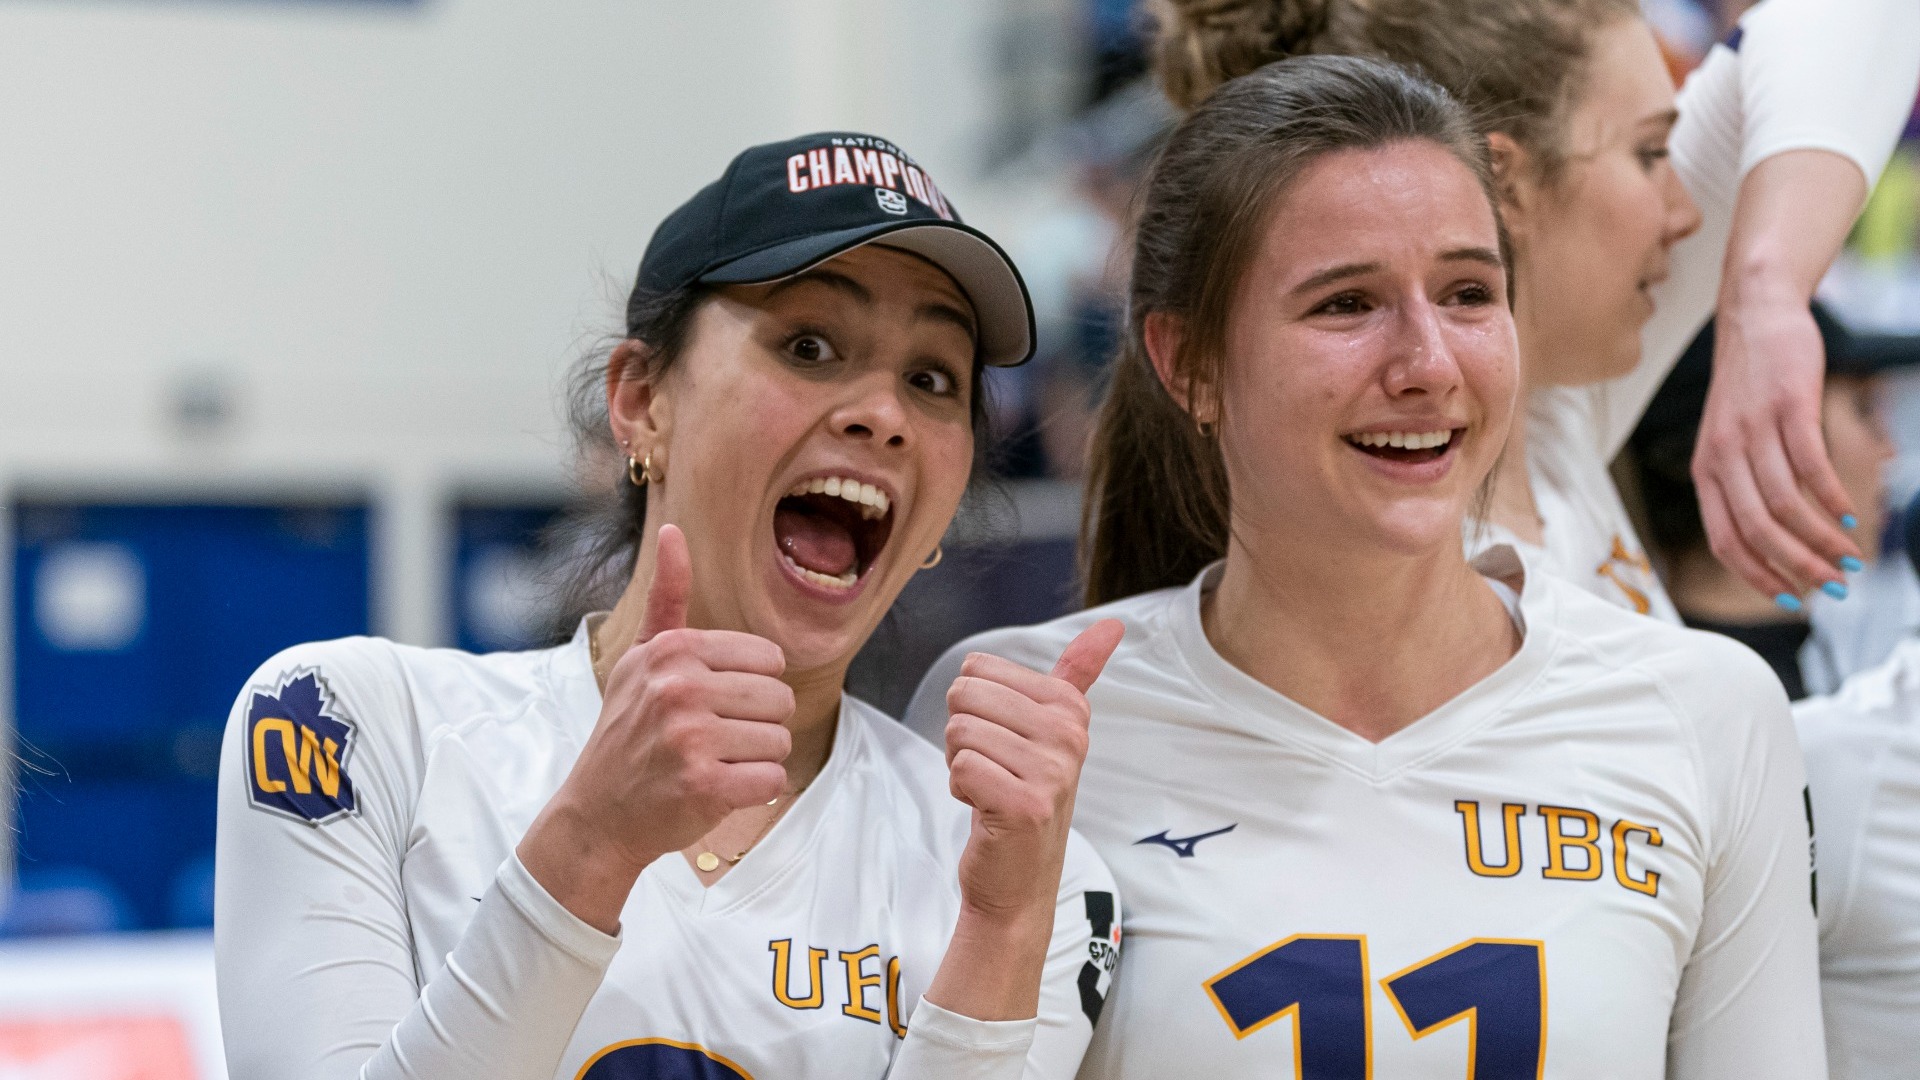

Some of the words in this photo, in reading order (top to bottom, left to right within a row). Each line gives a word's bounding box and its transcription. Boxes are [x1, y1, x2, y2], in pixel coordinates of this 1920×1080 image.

[831, 137, 917, 164] NATION
[1454, 800, 1664, 898] UBC
[1202, 932, 1550, 1080] 11
